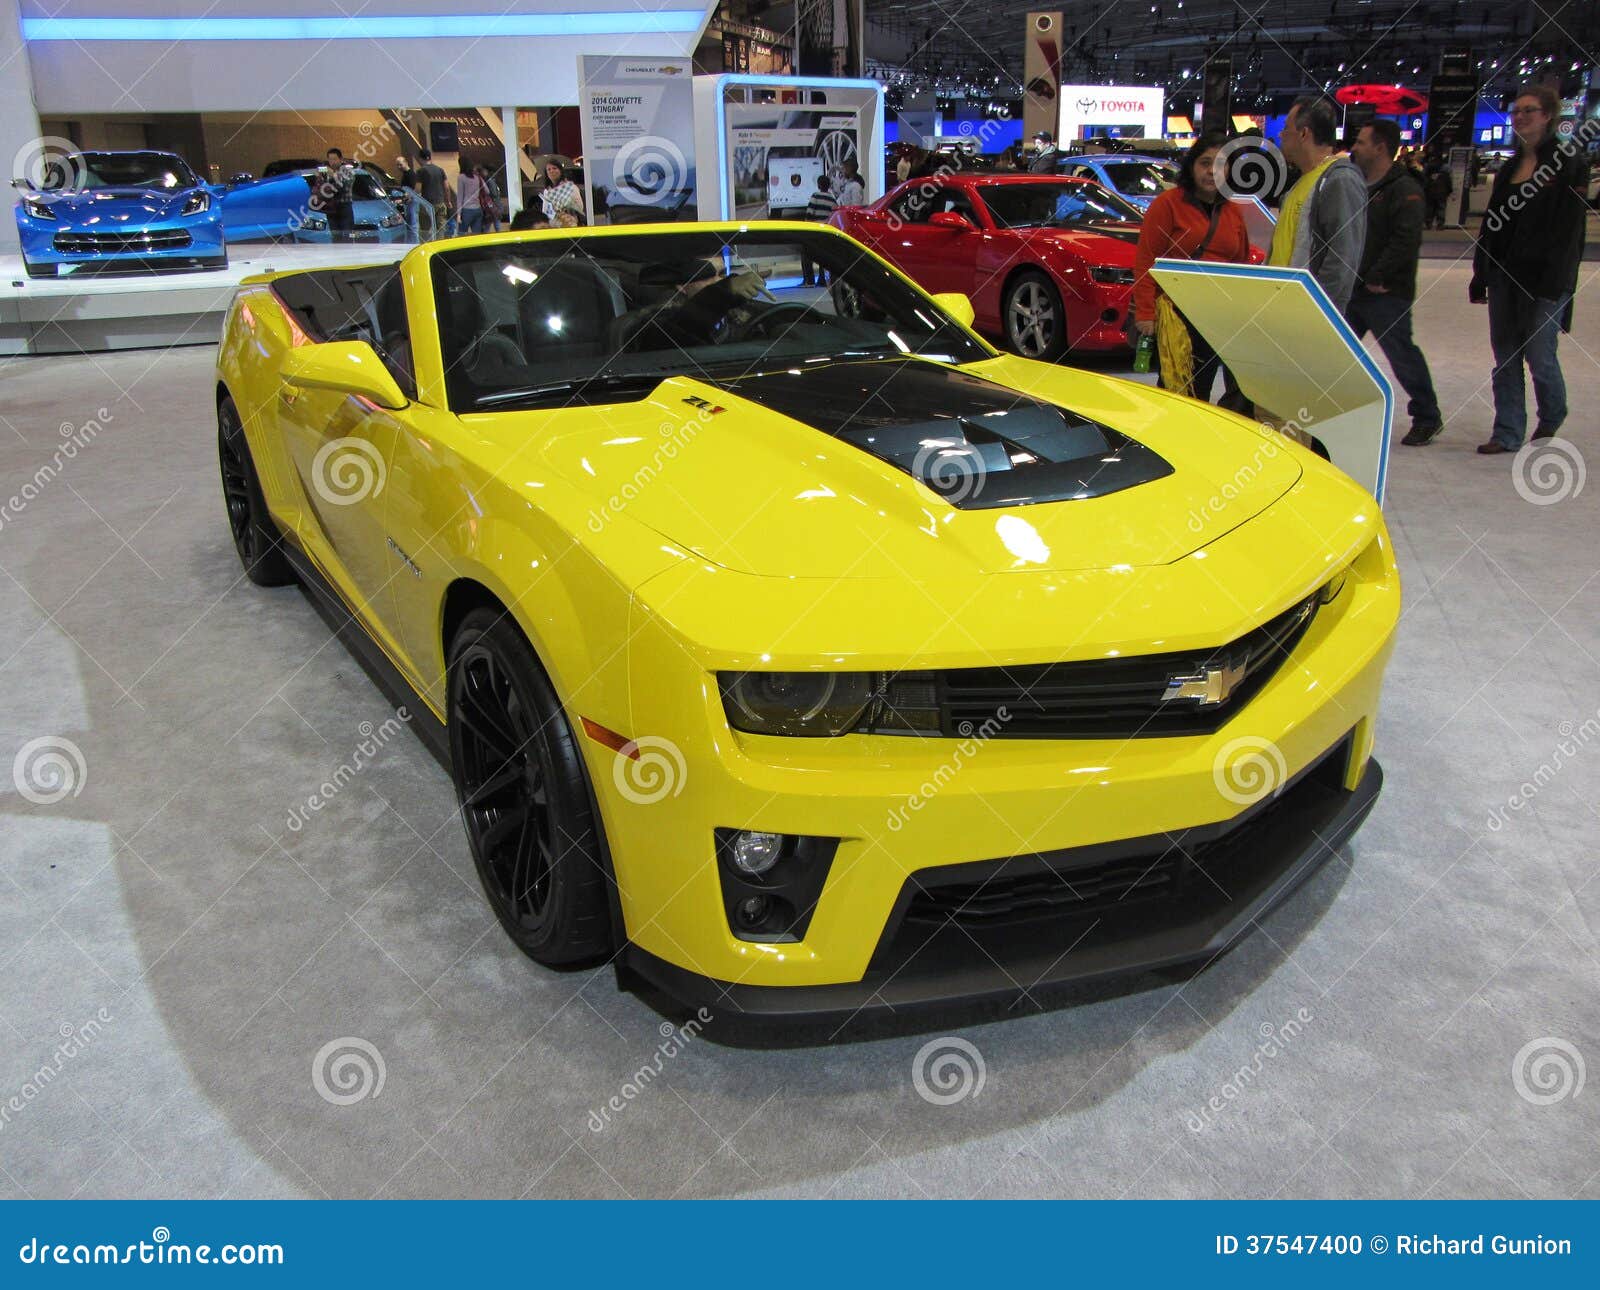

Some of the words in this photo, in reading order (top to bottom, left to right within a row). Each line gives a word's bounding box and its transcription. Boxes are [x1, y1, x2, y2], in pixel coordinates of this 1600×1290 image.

[592, 97, 607, 105] 2014
[608, 97, 643, 105] CORVETTE
[1101, 101, 1145, 112] TOYOTA
[458, 137, 494, 147] ETROIT
